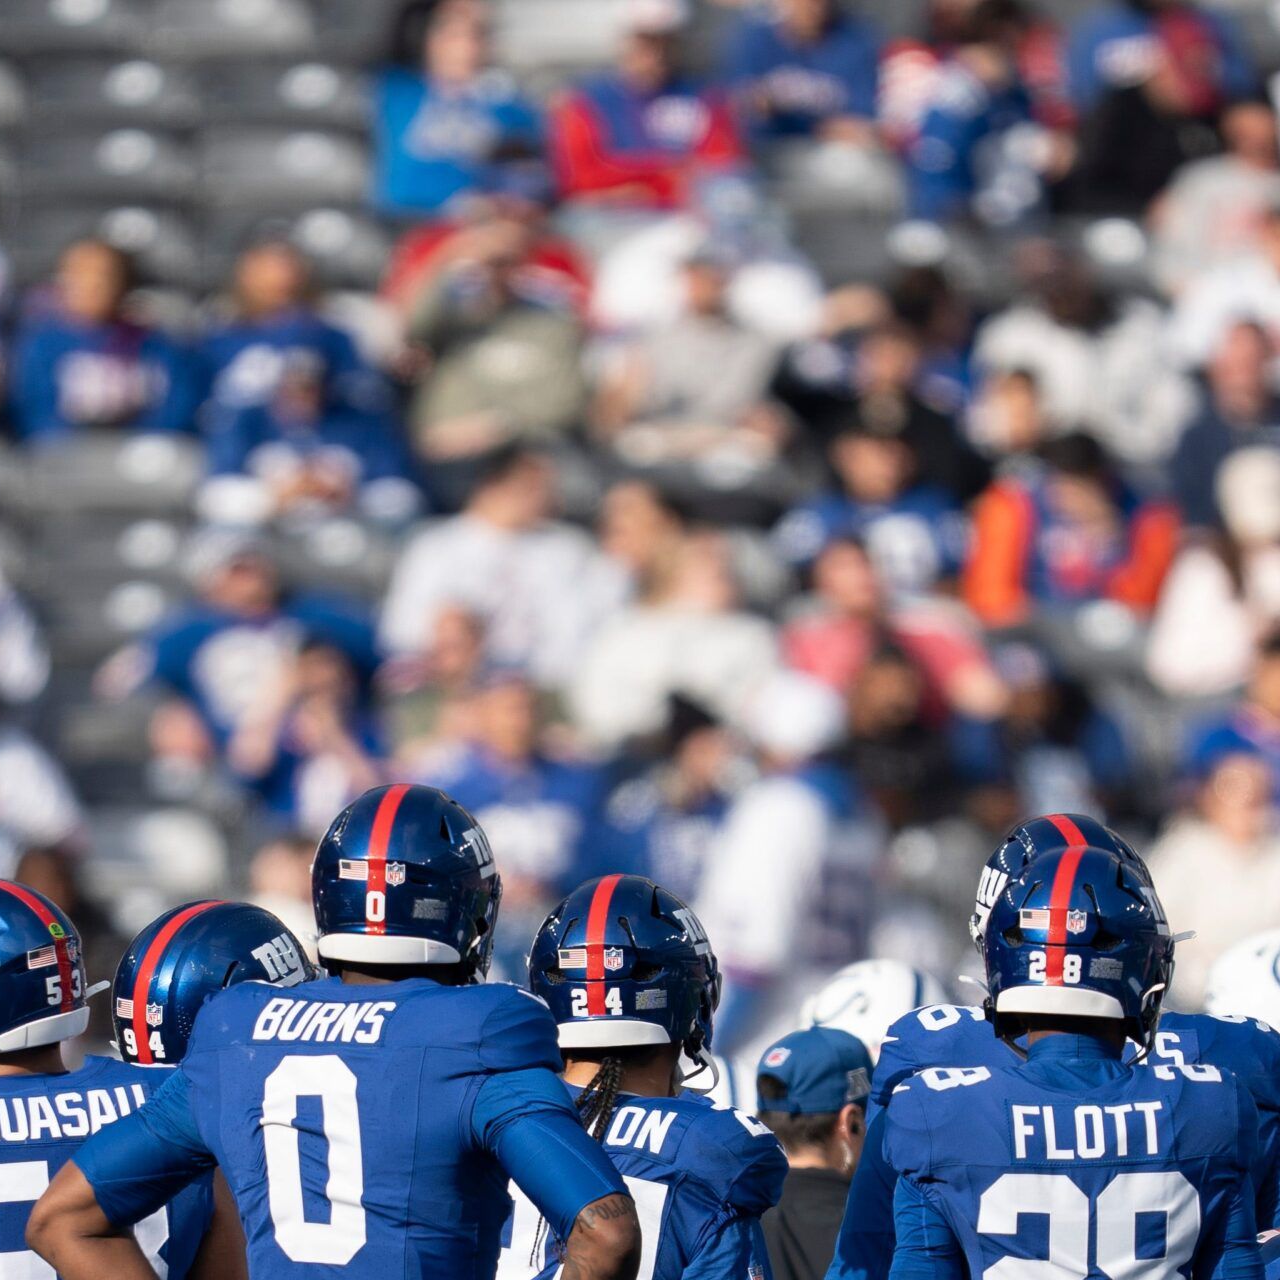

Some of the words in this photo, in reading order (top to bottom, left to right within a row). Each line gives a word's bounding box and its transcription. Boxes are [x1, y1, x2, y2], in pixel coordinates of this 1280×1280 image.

[366, 891, 386, 922] 0
[1029, 951, 1082, 984] 28
[45, 969, 81, 1006] 53
[571, 987, 623, 1017] 24
[252, 998, 397, 1044] BURNS
[123, 1028, 166, 1058] 94
[1011, 1101, 1163, 1160] FLOTT
[260, 1055, 366, 1265] 0
